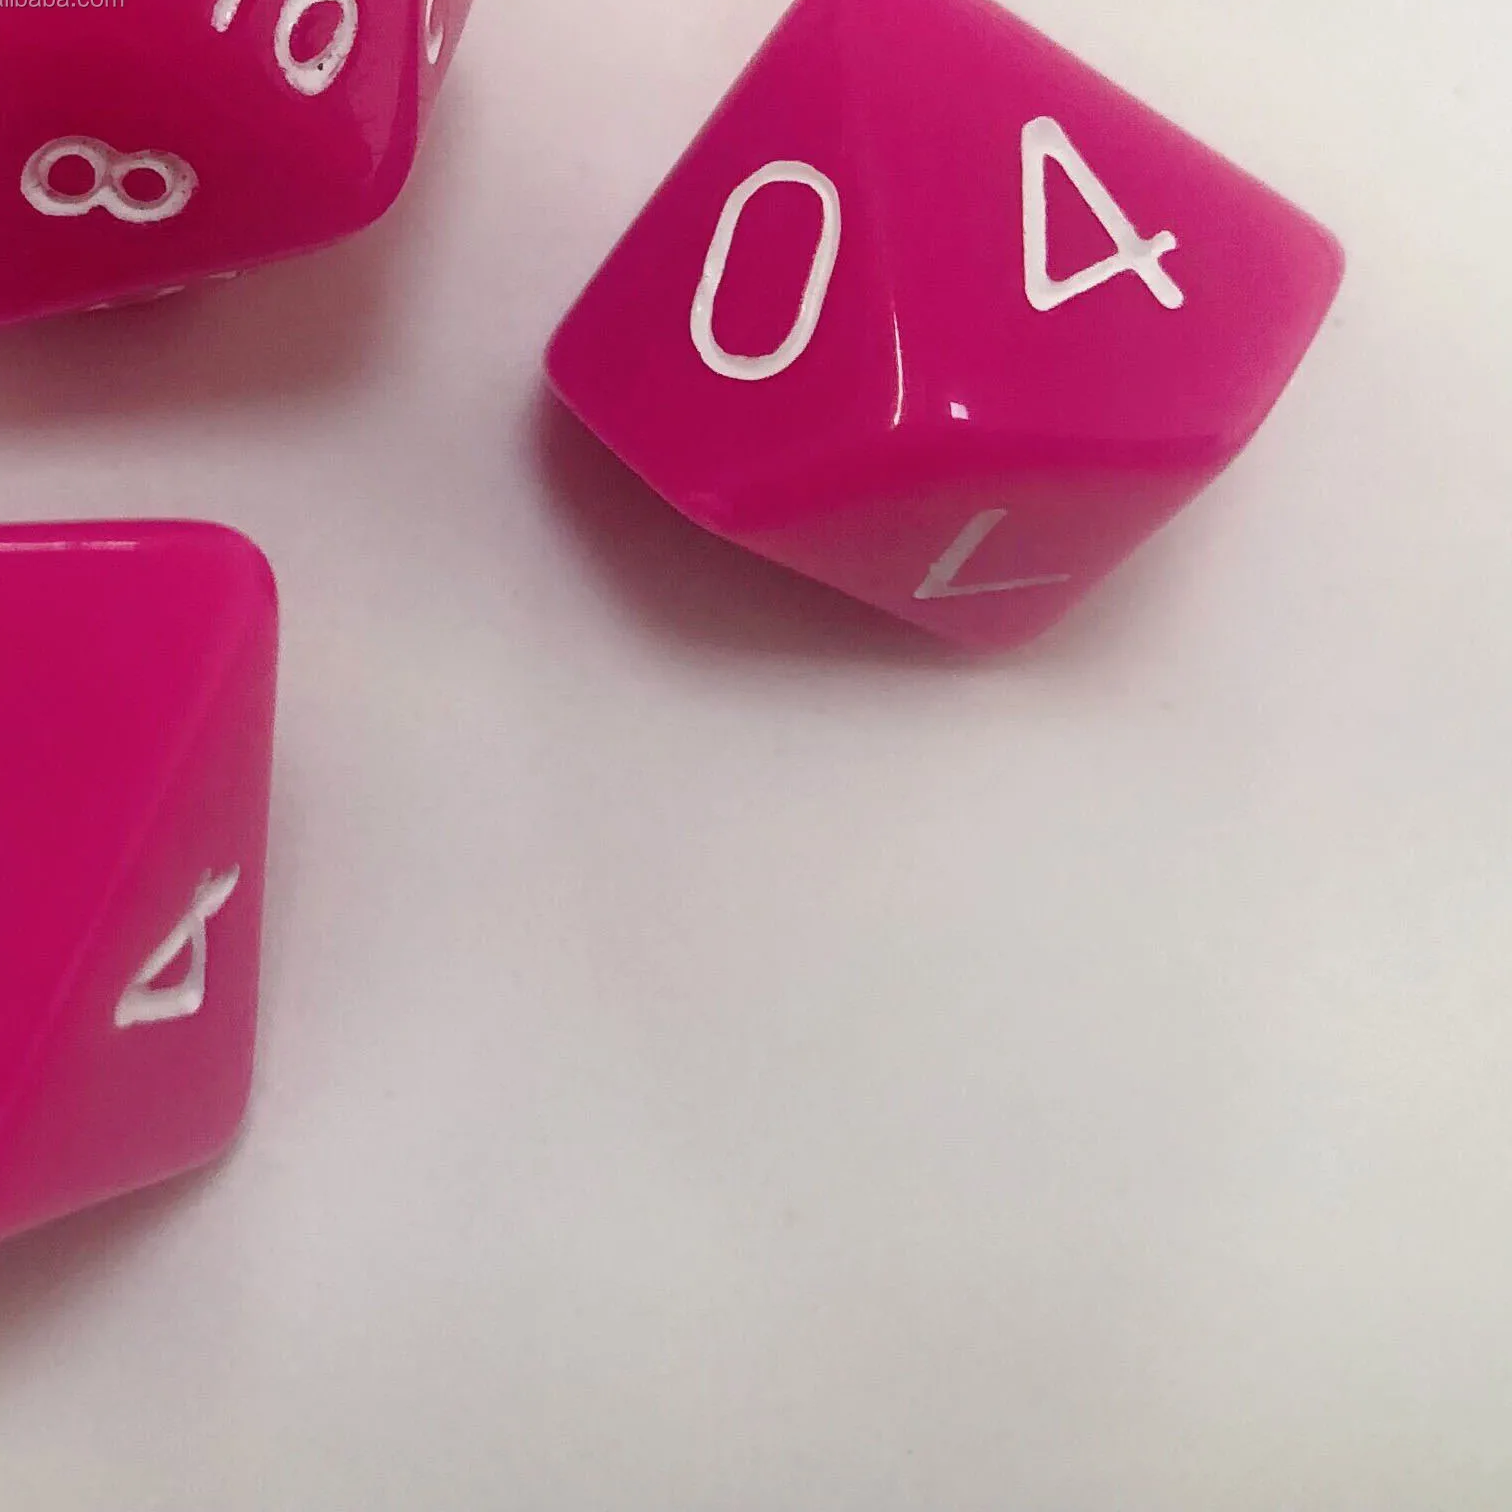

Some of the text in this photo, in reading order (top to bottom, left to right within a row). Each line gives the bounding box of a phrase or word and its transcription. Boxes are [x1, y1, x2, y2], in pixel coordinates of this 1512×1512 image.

[20, 136, 198, 223] 8
[1021, 116, 1185, 311] 4
[690, 160, 842, 381] 0
[913, 509, 1071, 600] 7
[114, 864, 240, 1029] 4
